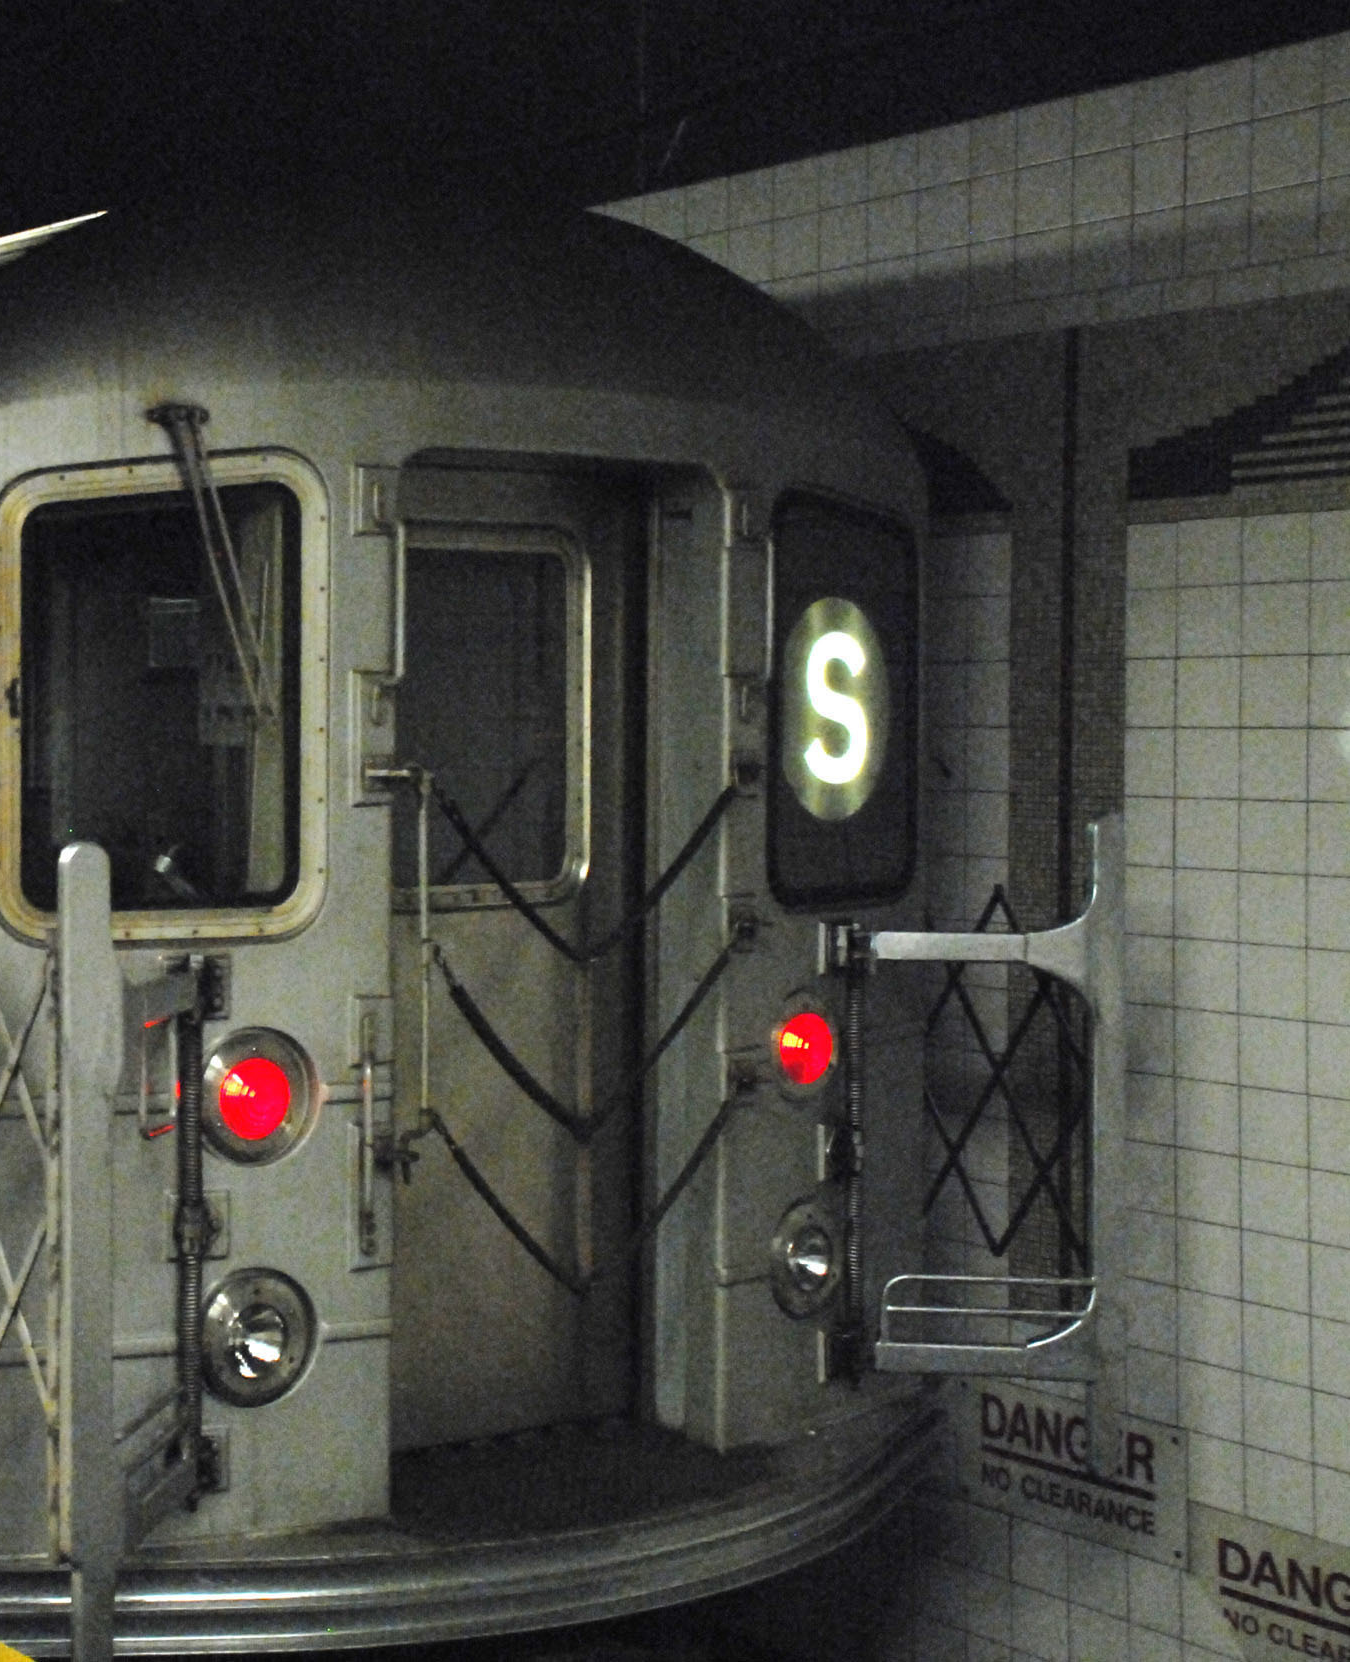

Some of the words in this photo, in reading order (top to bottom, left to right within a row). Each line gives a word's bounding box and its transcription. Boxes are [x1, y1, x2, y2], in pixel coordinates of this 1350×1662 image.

[804, 630, 867, 784] S
[981, 1393, 1155, 1483] DANGR
[981, 1462, 1011, 1492] NO
[1021, 1474, 1155, 1537] CLEARANCE
[1223, 1607, 1259, 1635] NO
